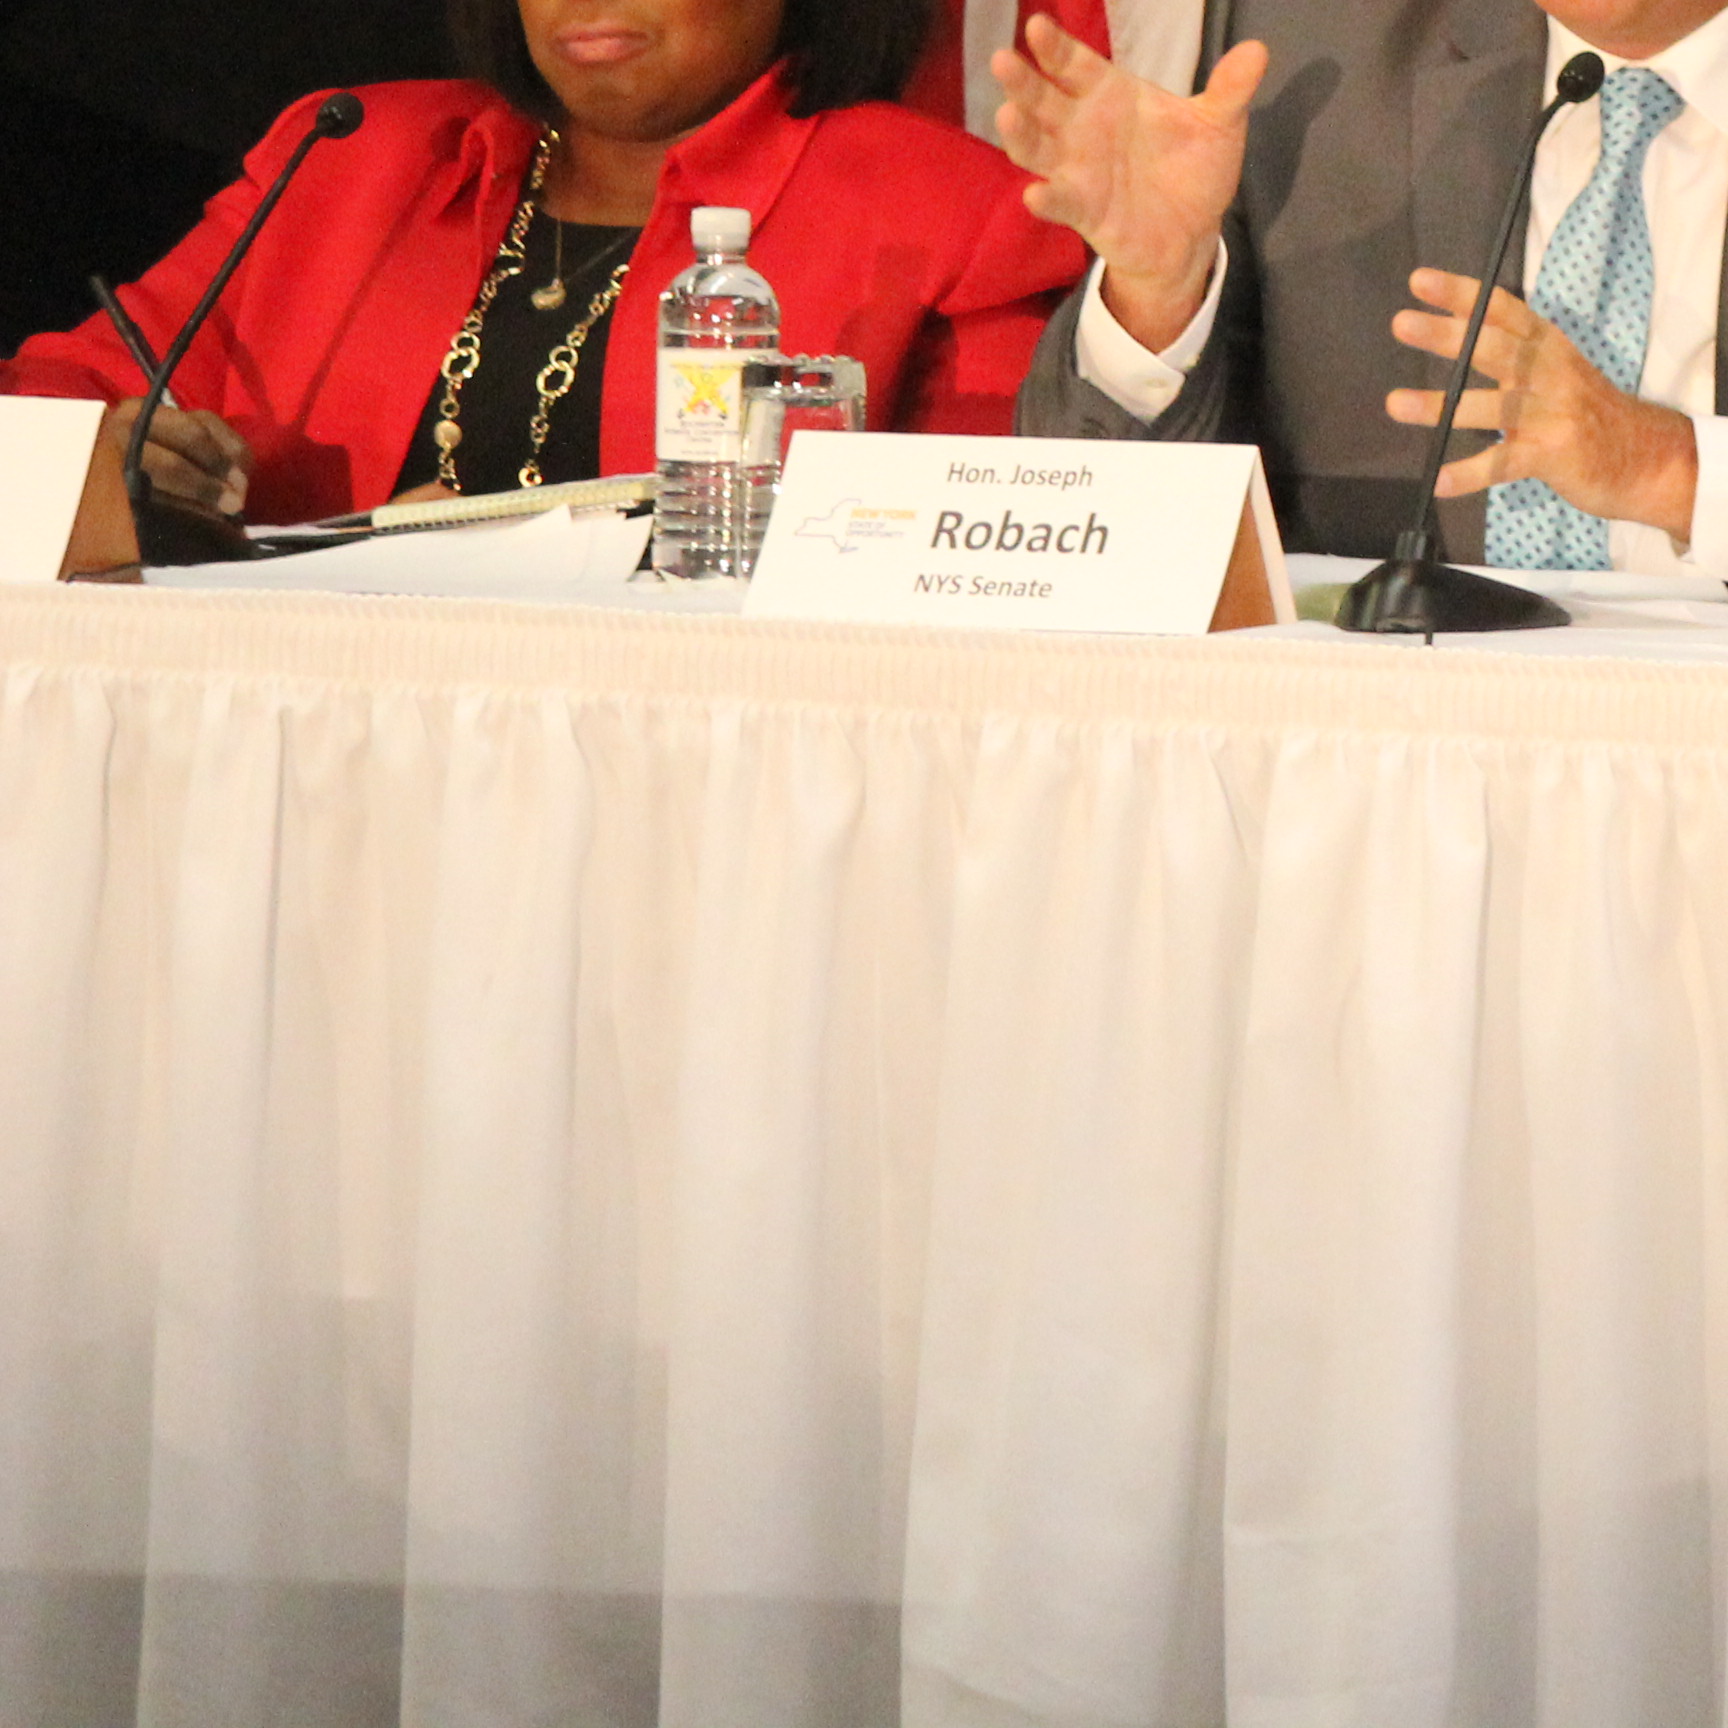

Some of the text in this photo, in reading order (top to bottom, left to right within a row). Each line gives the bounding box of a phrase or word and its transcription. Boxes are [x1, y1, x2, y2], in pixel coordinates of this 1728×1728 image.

[947, 463, 1093, 490] Hon. Joseph
[931, 510, 1108, 554] Robach
[915, 574, 1052, 597] NYS Senate
